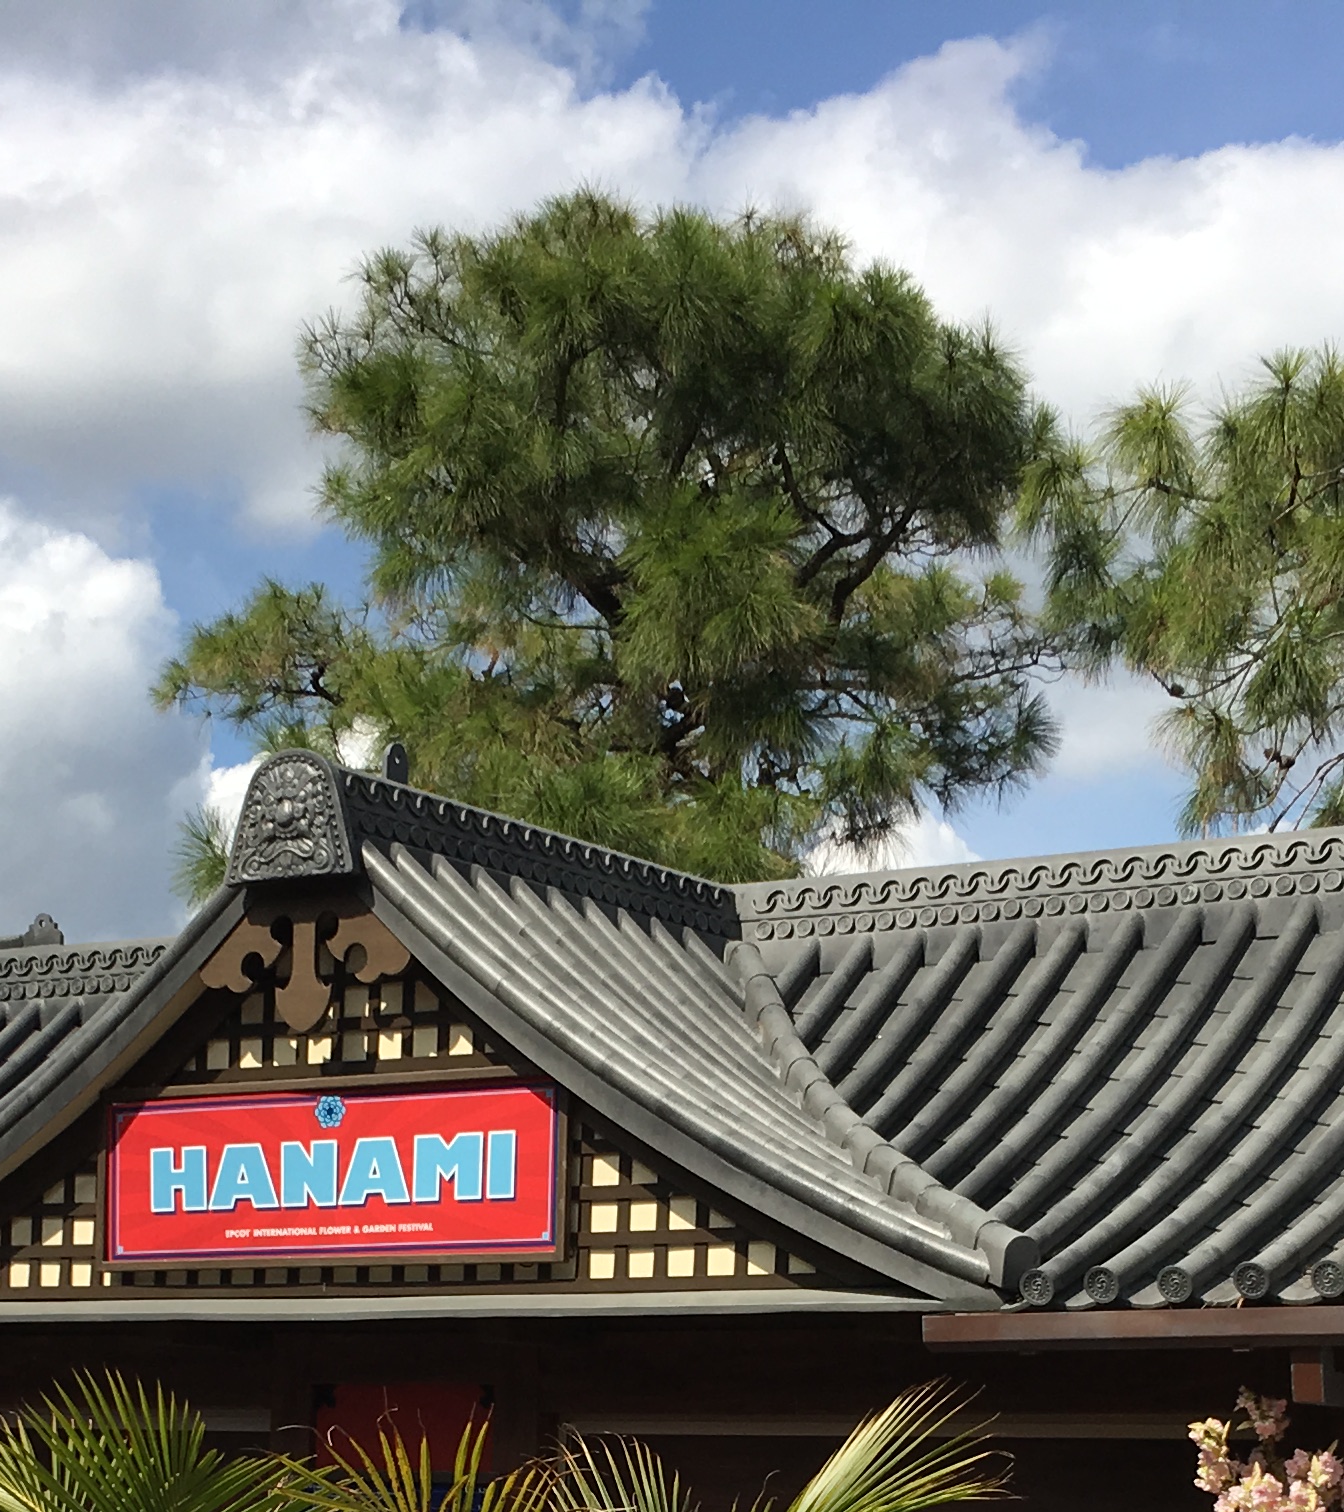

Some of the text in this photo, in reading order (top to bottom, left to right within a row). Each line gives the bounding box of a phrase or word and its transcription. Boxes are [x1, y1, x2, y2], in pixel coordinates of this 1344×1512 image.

[149, 1129, 517, 1213] HANAMI
[225, 1223, 433, 1238] EPCOT INTERNATIONAL FLOWER & GARDEN FESTIVAL
